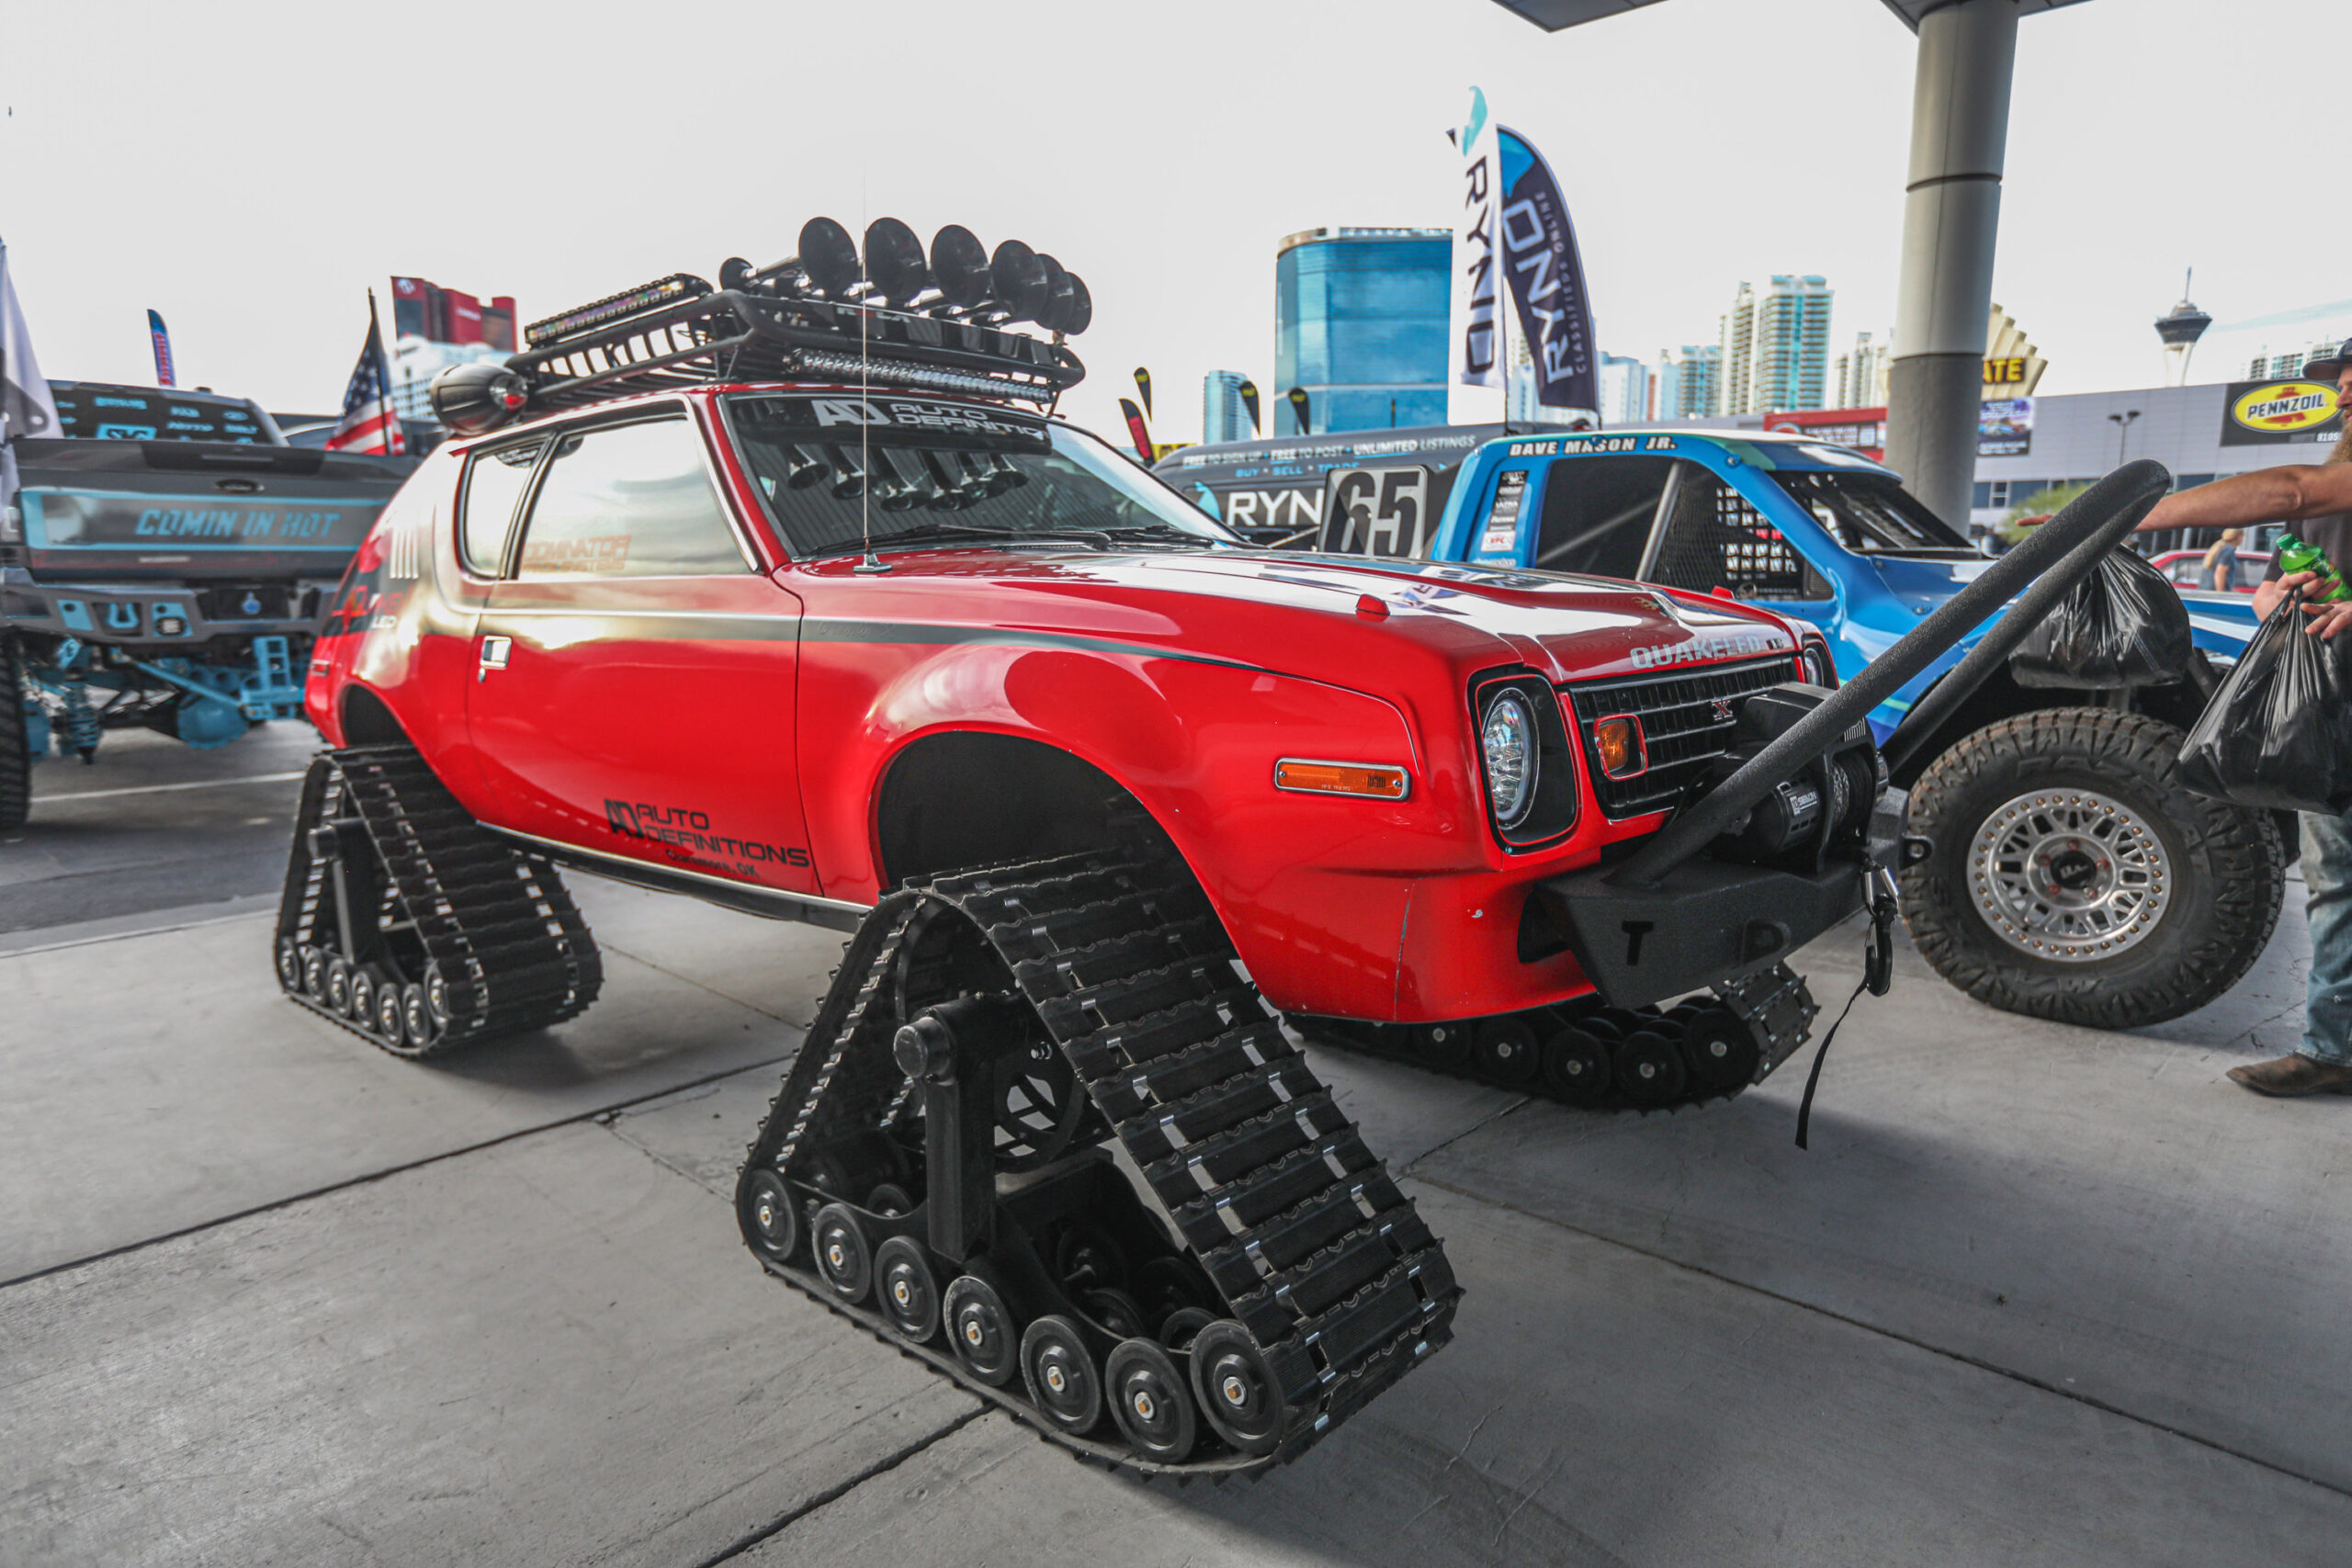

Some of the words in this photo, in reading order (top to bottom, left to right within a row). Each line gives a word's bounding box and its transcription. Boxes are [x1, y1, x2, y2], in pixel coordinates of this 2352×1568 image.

[1535, 191, 1564, 253] ONLINE
[1465, 155, 1495, 375] RYNO
[1501, 198, 1574, 384] RYNO
[1559, 261, 1587, 374] CLASSIFIEDS
[889, 403, 989, 420] AUTO
[2246, 392, 2325, 421] PENNZOIL
[895, 414, 1045, 441] DEFINITIO
[1183, 455, 1206, 466] FREE
[1208, 454, 1220, 464] TO
[1271, 449, 1297, 460] FREE
[1298, 448, 1314, 458] TO
[1315, 446, 1344, 457] POST
[1353, 439, 1419, 456] UNLIMITED
[1419, 435, 1476, 451] LISTINGS
[1510, 441, 1559, 457] DAVE
[1564, 437, 1637, 455] MASON
[1645, 436, 1678, 450] JR.
[1236, 468, 1261, 477] BUY
[1272, 466, 1304, 476] SELL
[1227, 489, 1324, 526] RYN
[1328, 471, 1420, 558] 65
[243, 511, 277, 537] IN
[279, 512, 341, 537] HOT
[1712, 699, 1734, 721] X
[636, 803, 710, 831] AUTO
[644, 825, 810, 868] DEFINITIONS
